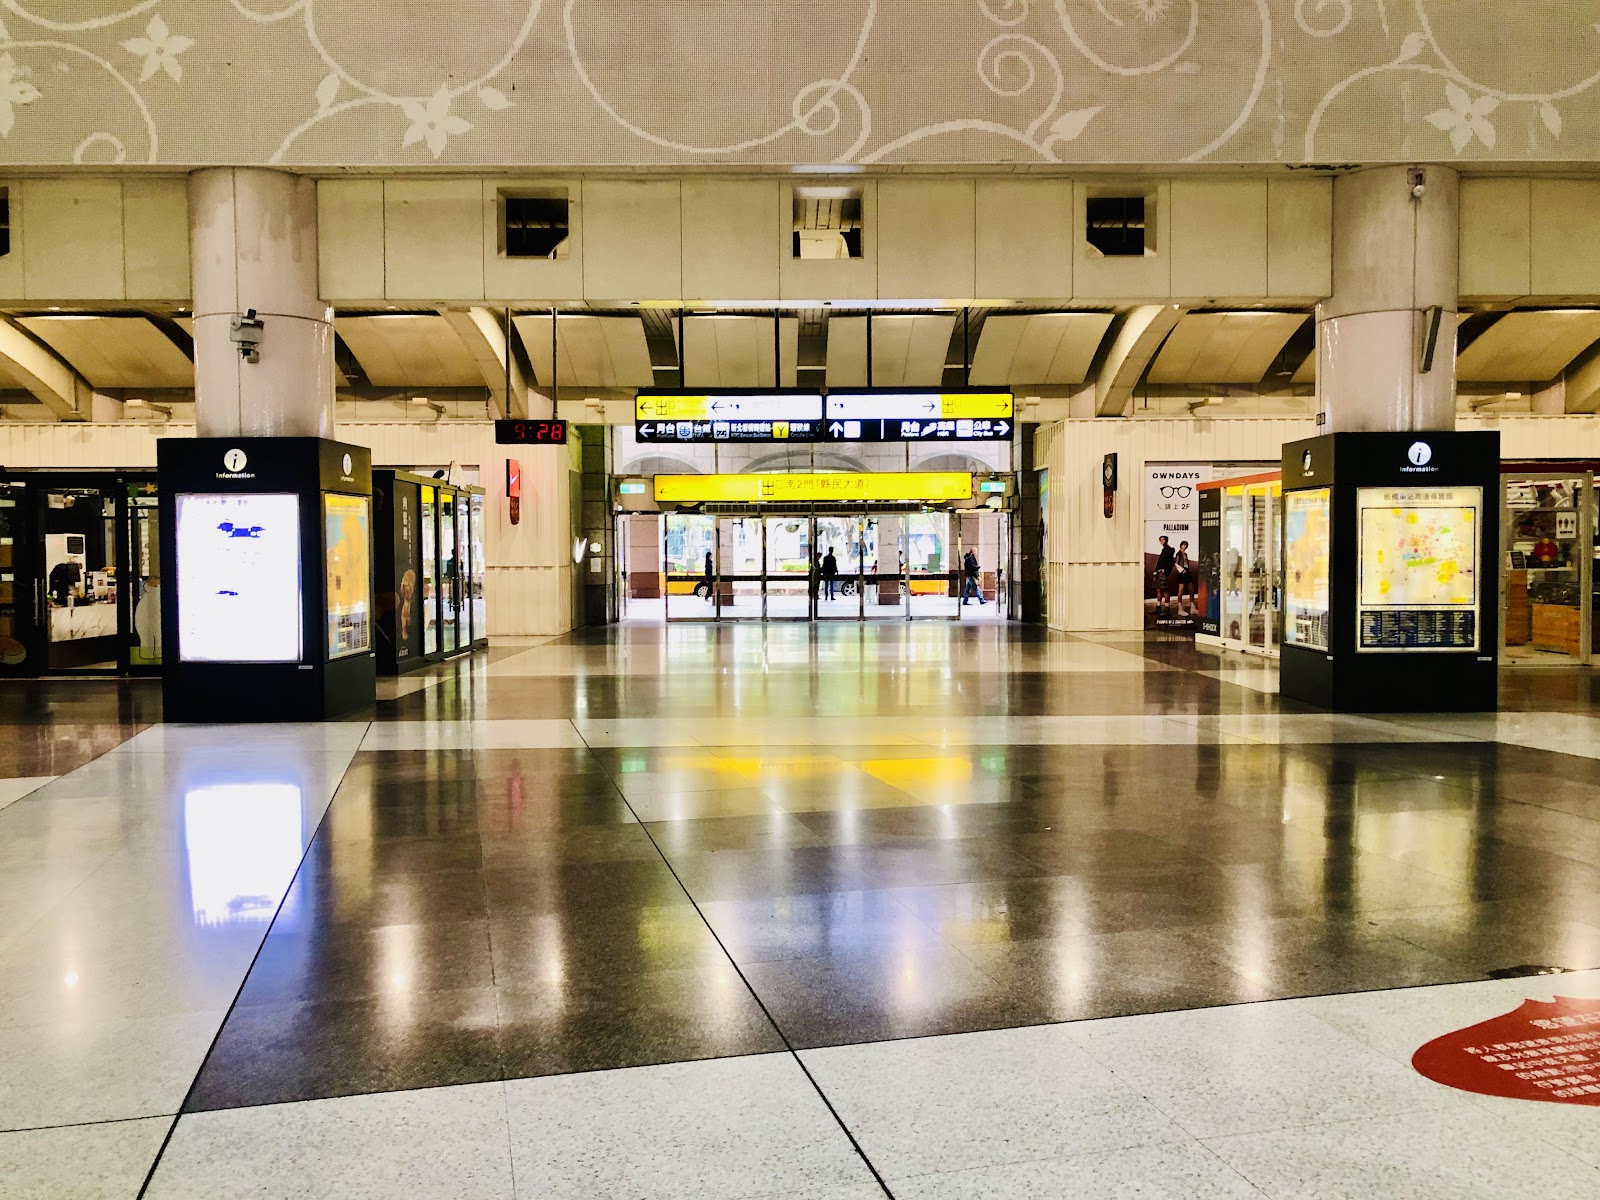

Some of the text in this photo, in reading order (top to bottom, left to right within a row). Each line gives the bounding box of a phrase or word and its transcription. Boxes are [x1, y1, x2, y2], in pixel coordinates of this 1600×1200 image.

[655, 399, 676, 416] 出口
[514, 423, 563, 440] 9:28
[1163, 523, 1189, 531] PALLADIUM
